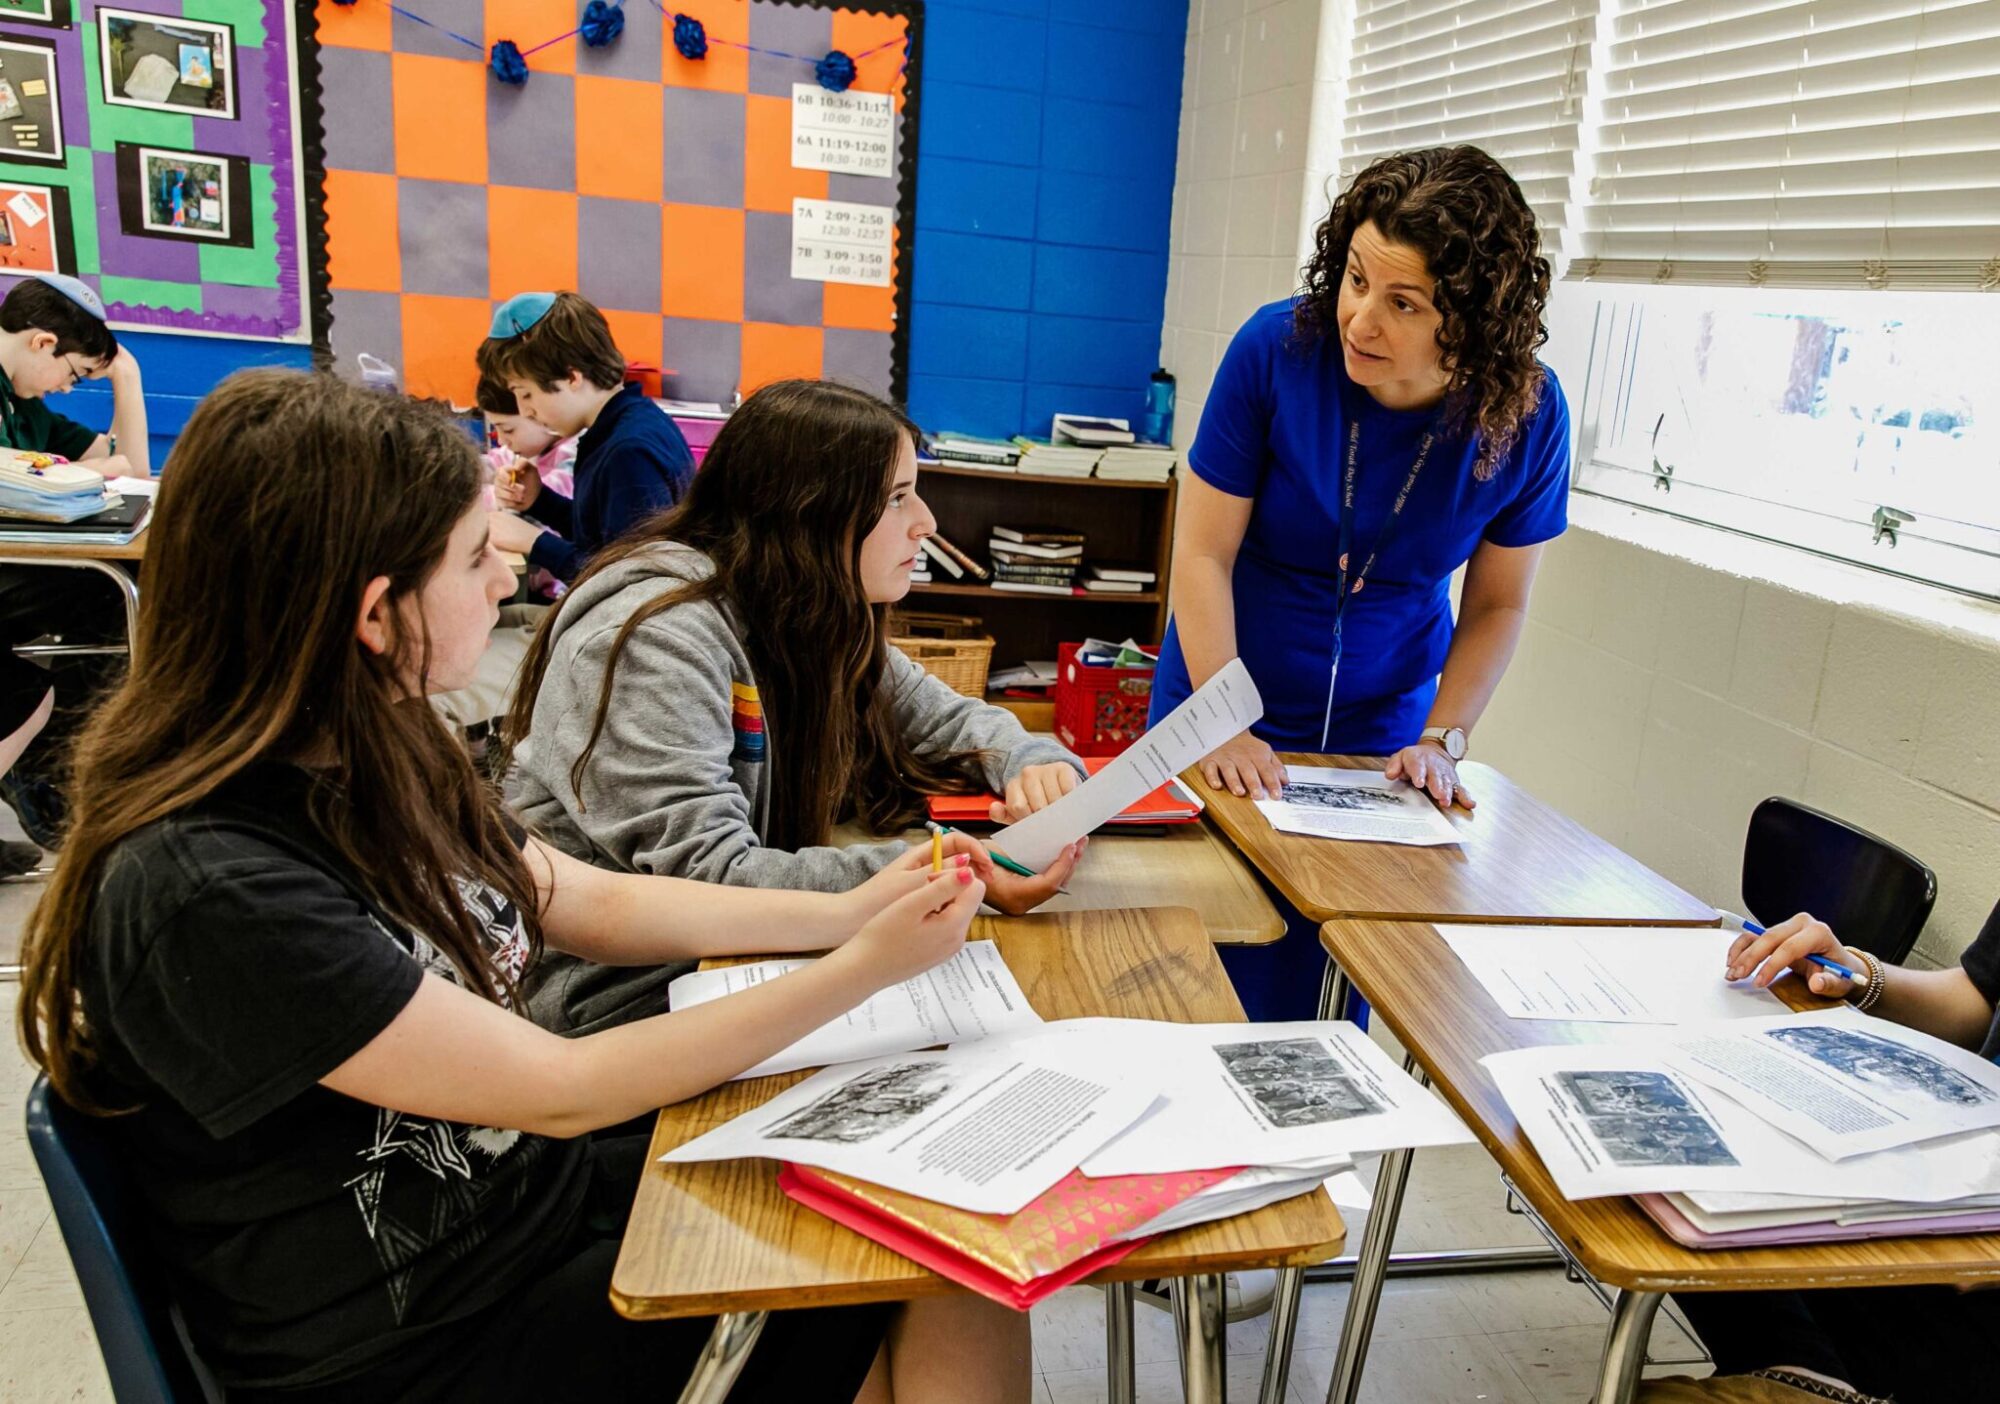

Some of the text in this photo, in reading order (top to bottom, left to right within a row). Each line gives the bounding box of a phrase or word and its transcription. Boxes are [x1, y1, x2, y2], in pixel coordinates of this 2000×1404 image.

[798, 94, 813, 104] 6B
[797, 136, 886, 153] 6A 11:19-12:00
[798, 208, 813, 218] 7A
[825, 210, 850, 221] 2:09
[859, 214, 884, 225] 2:50
[797, 247, 812, 257] 7B
[824, 249, 849, 261] 3:09
[858, 252, 882, 264] 3:50
